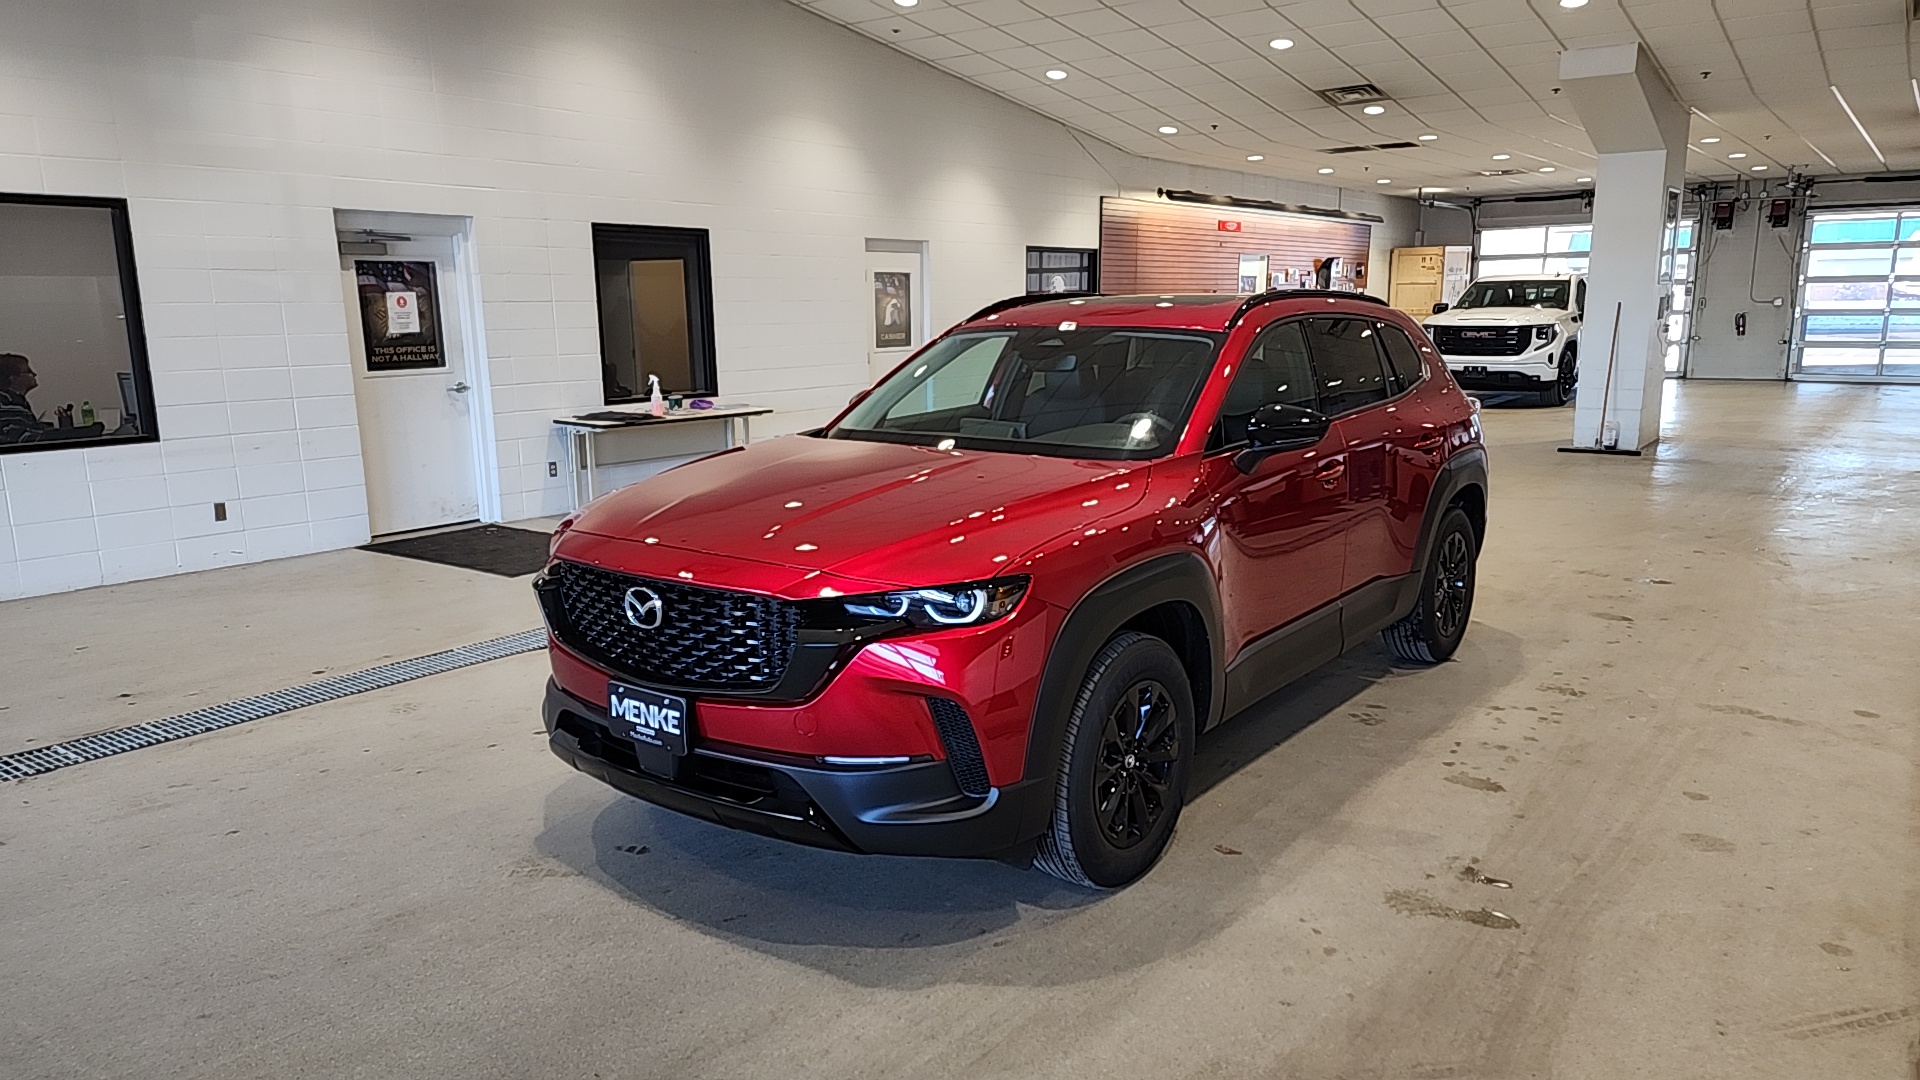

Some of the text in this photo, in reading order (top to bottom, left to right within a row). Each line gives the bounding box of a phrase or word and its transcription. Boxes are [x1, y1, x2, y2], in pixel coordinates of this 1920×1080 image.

[1461, 331, 1497, 339] GMC
[373, 344, 436, 355] THIS OFFICE IS
[371, 355, 390, 363] NOT
[610, 694, 681, 736] MENKE
